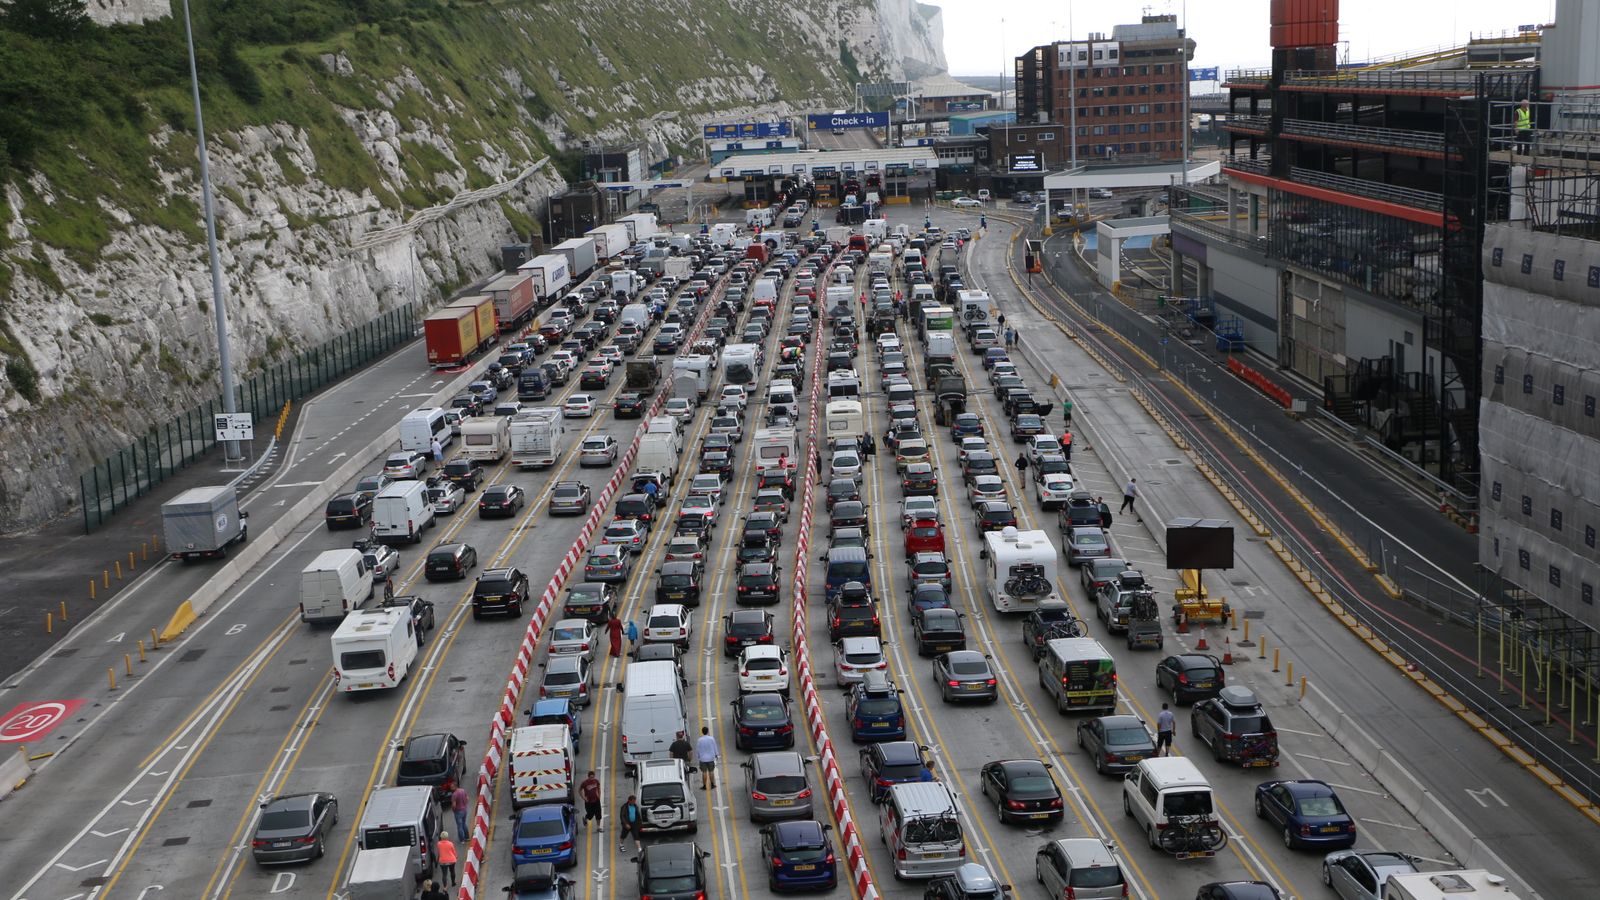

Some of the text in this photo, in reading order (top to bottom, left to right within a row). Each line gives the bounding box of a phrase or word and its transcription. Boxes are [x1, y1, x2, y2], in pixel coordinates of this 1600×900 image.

[831, 116, 859, 126] Check
[866, 116, 875, 124] in
[225, 624, 247, 635] B
[106, 632, 126, 642] A
[5, 714, 52, 729] 20
[1464, 788, 1509, 807] M
[270, 872, 296, 894] D
